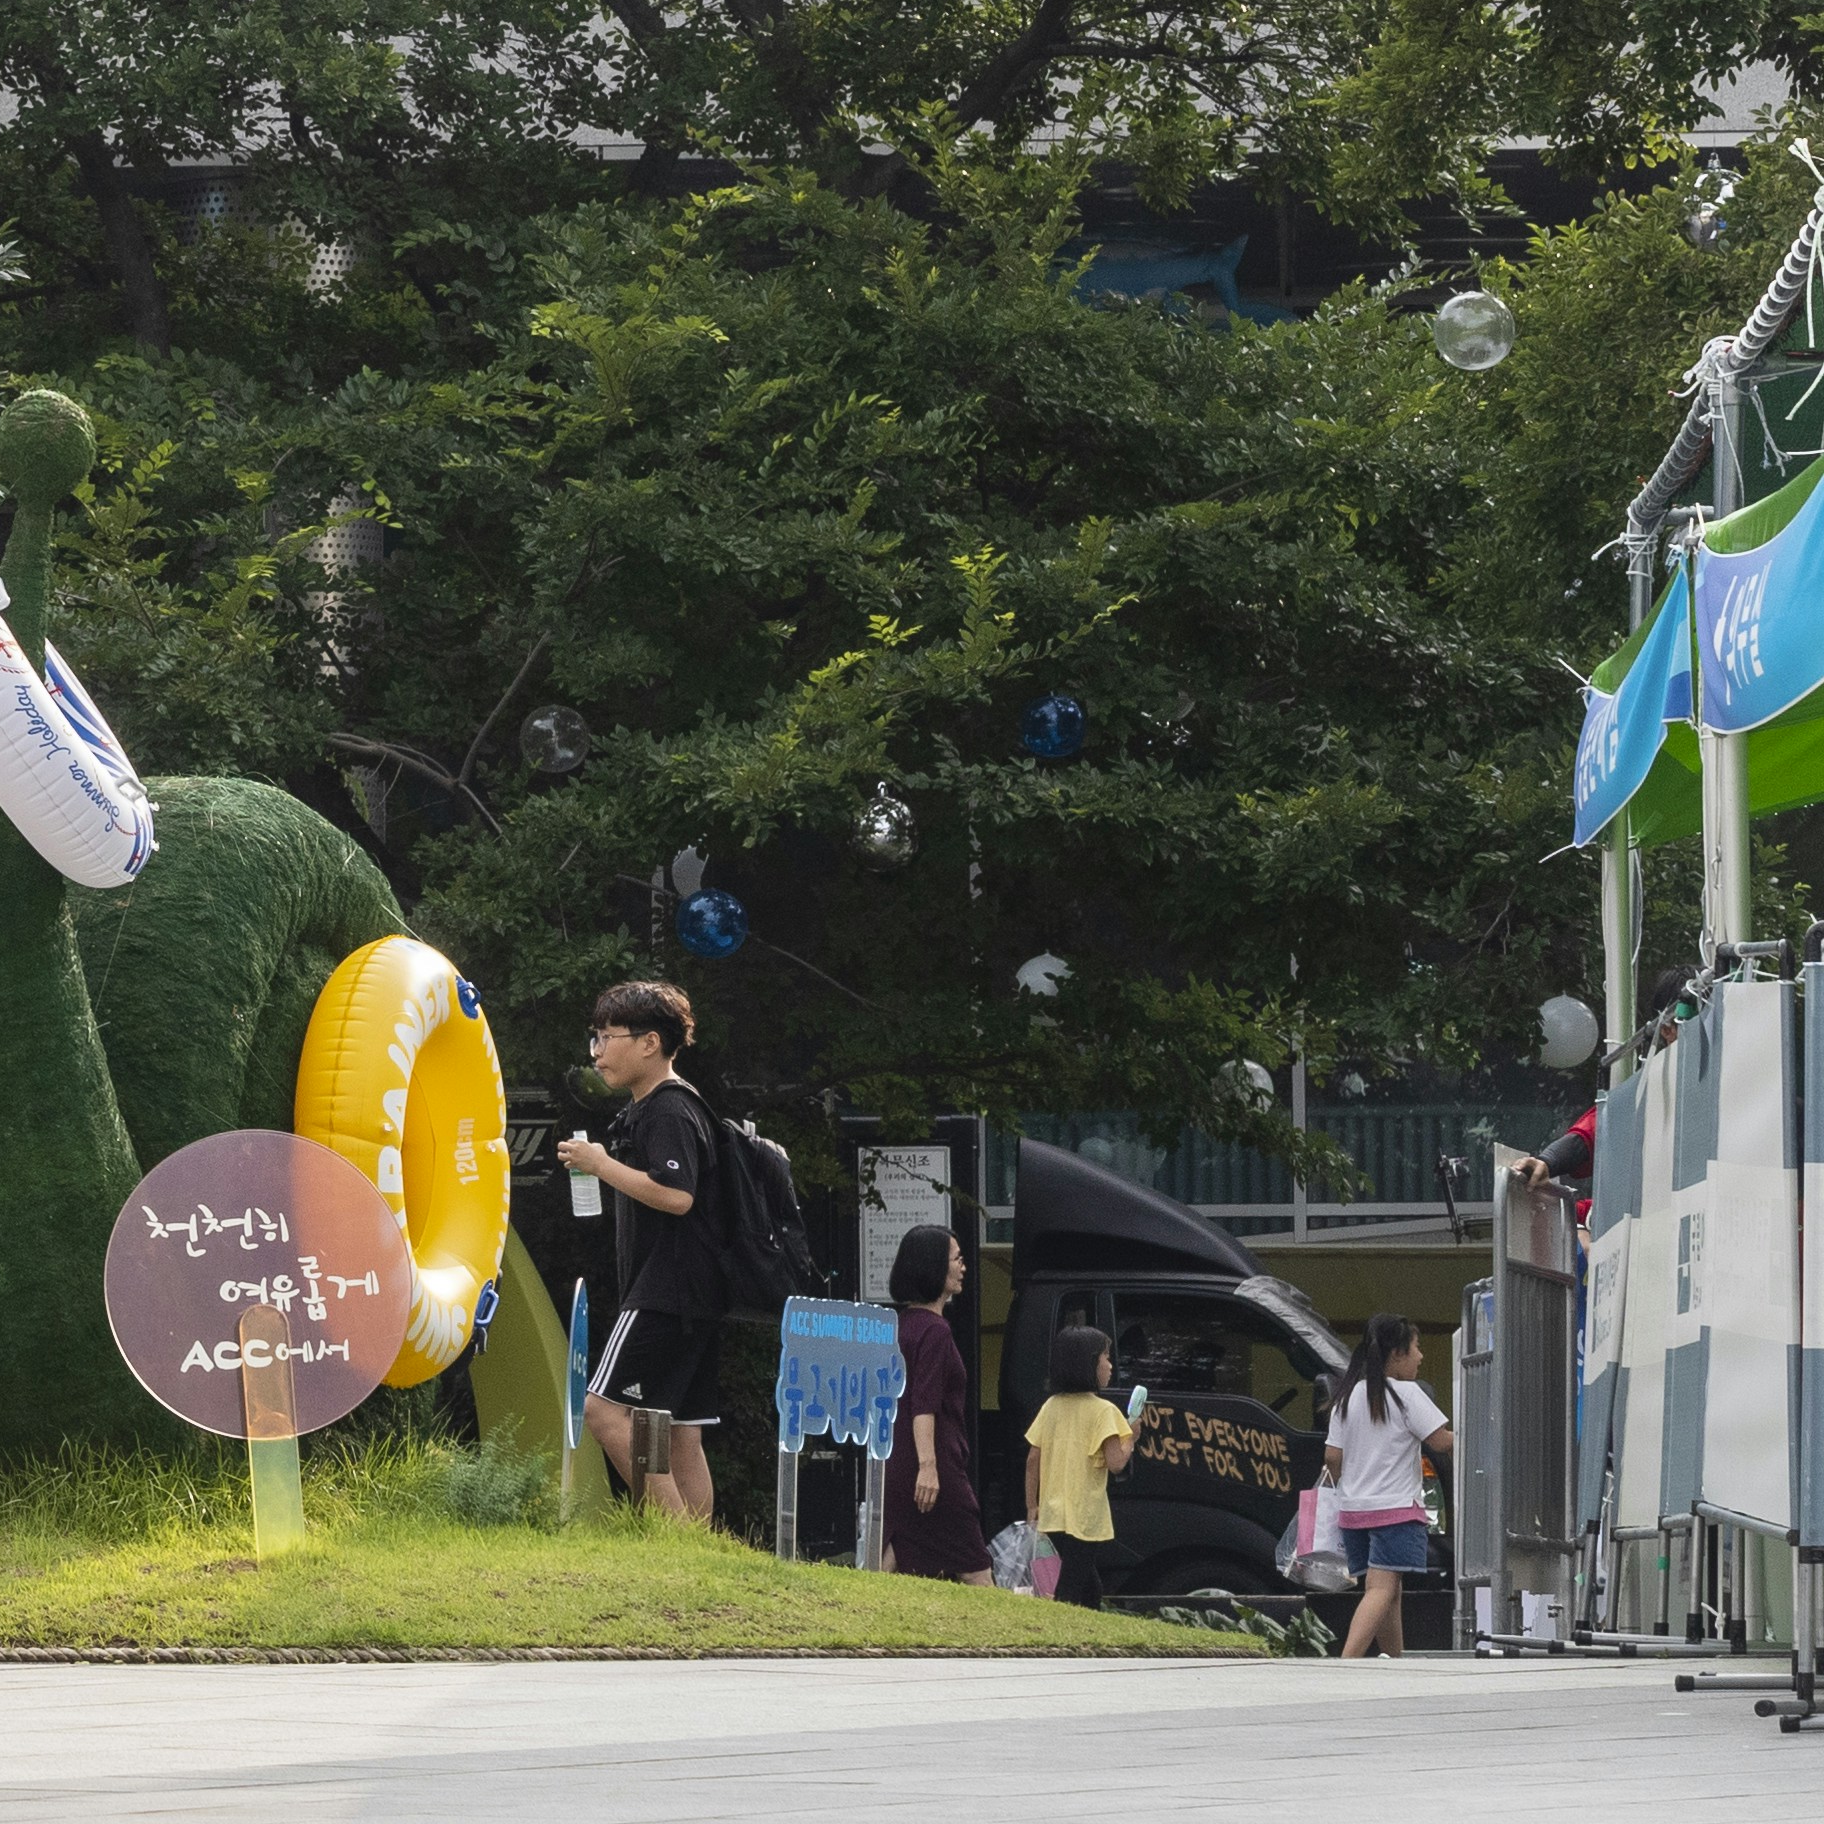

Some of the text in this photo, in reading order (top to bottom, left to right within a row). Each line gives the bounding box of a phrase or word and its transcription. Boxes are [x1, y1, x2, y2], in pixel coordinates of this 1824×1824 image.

[14, 684, 121, 833] Summer Holiday
[453, 1116, 480, 1186] 120cm
[141, 1203, 290, 1258] 천천히
[219, 1255, 380, 1322] 여유롭게
[789, 1311, 810, 1337] ACC
[812, 1312, 854, 1343] SUMMER
[1138, 1435, 1292, 1493] JUST FOR YOU
[1184, 1411, 1291, 1463] EVERYONE
